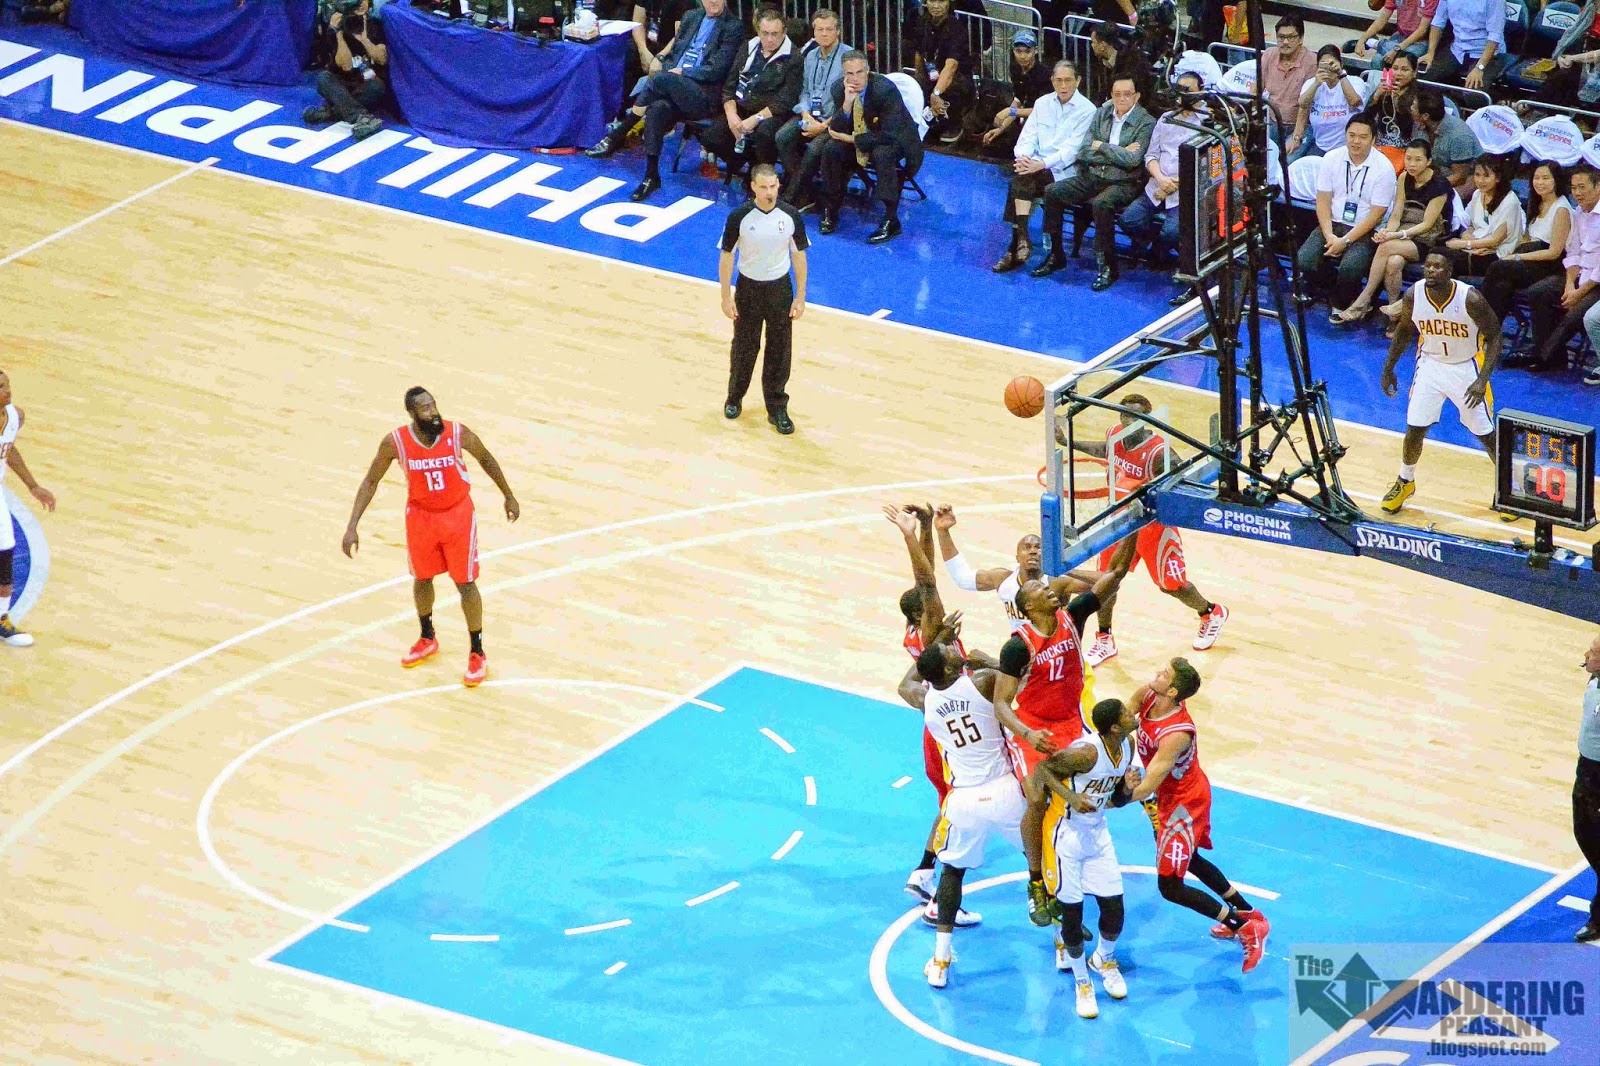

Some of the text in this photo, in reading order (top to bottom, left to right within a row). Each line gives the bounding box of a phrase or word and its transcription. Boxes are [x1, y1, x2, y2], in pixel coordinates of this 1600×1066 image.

[1419, 319, 1469, 338] PACERS
[1442, 341, 1449, 357] 1
[408, 455, 456, 471] ROCKETS
[1113, 454, 1143, 478] OCKETS
[424, 470, 446, 492] 13
[1224, 510, 1291, 531] PHOENIX
[1224, 520, 1292, 541] Petroleum
[1356, 527, 1443, 563] SPALDING
[1036, 638, 1076, 666] ROCKETS
[1048, 656, 1065, 681] 12
[936, 700, 971, 718] HIBBERT
[946, 714, 982, 748] 55
